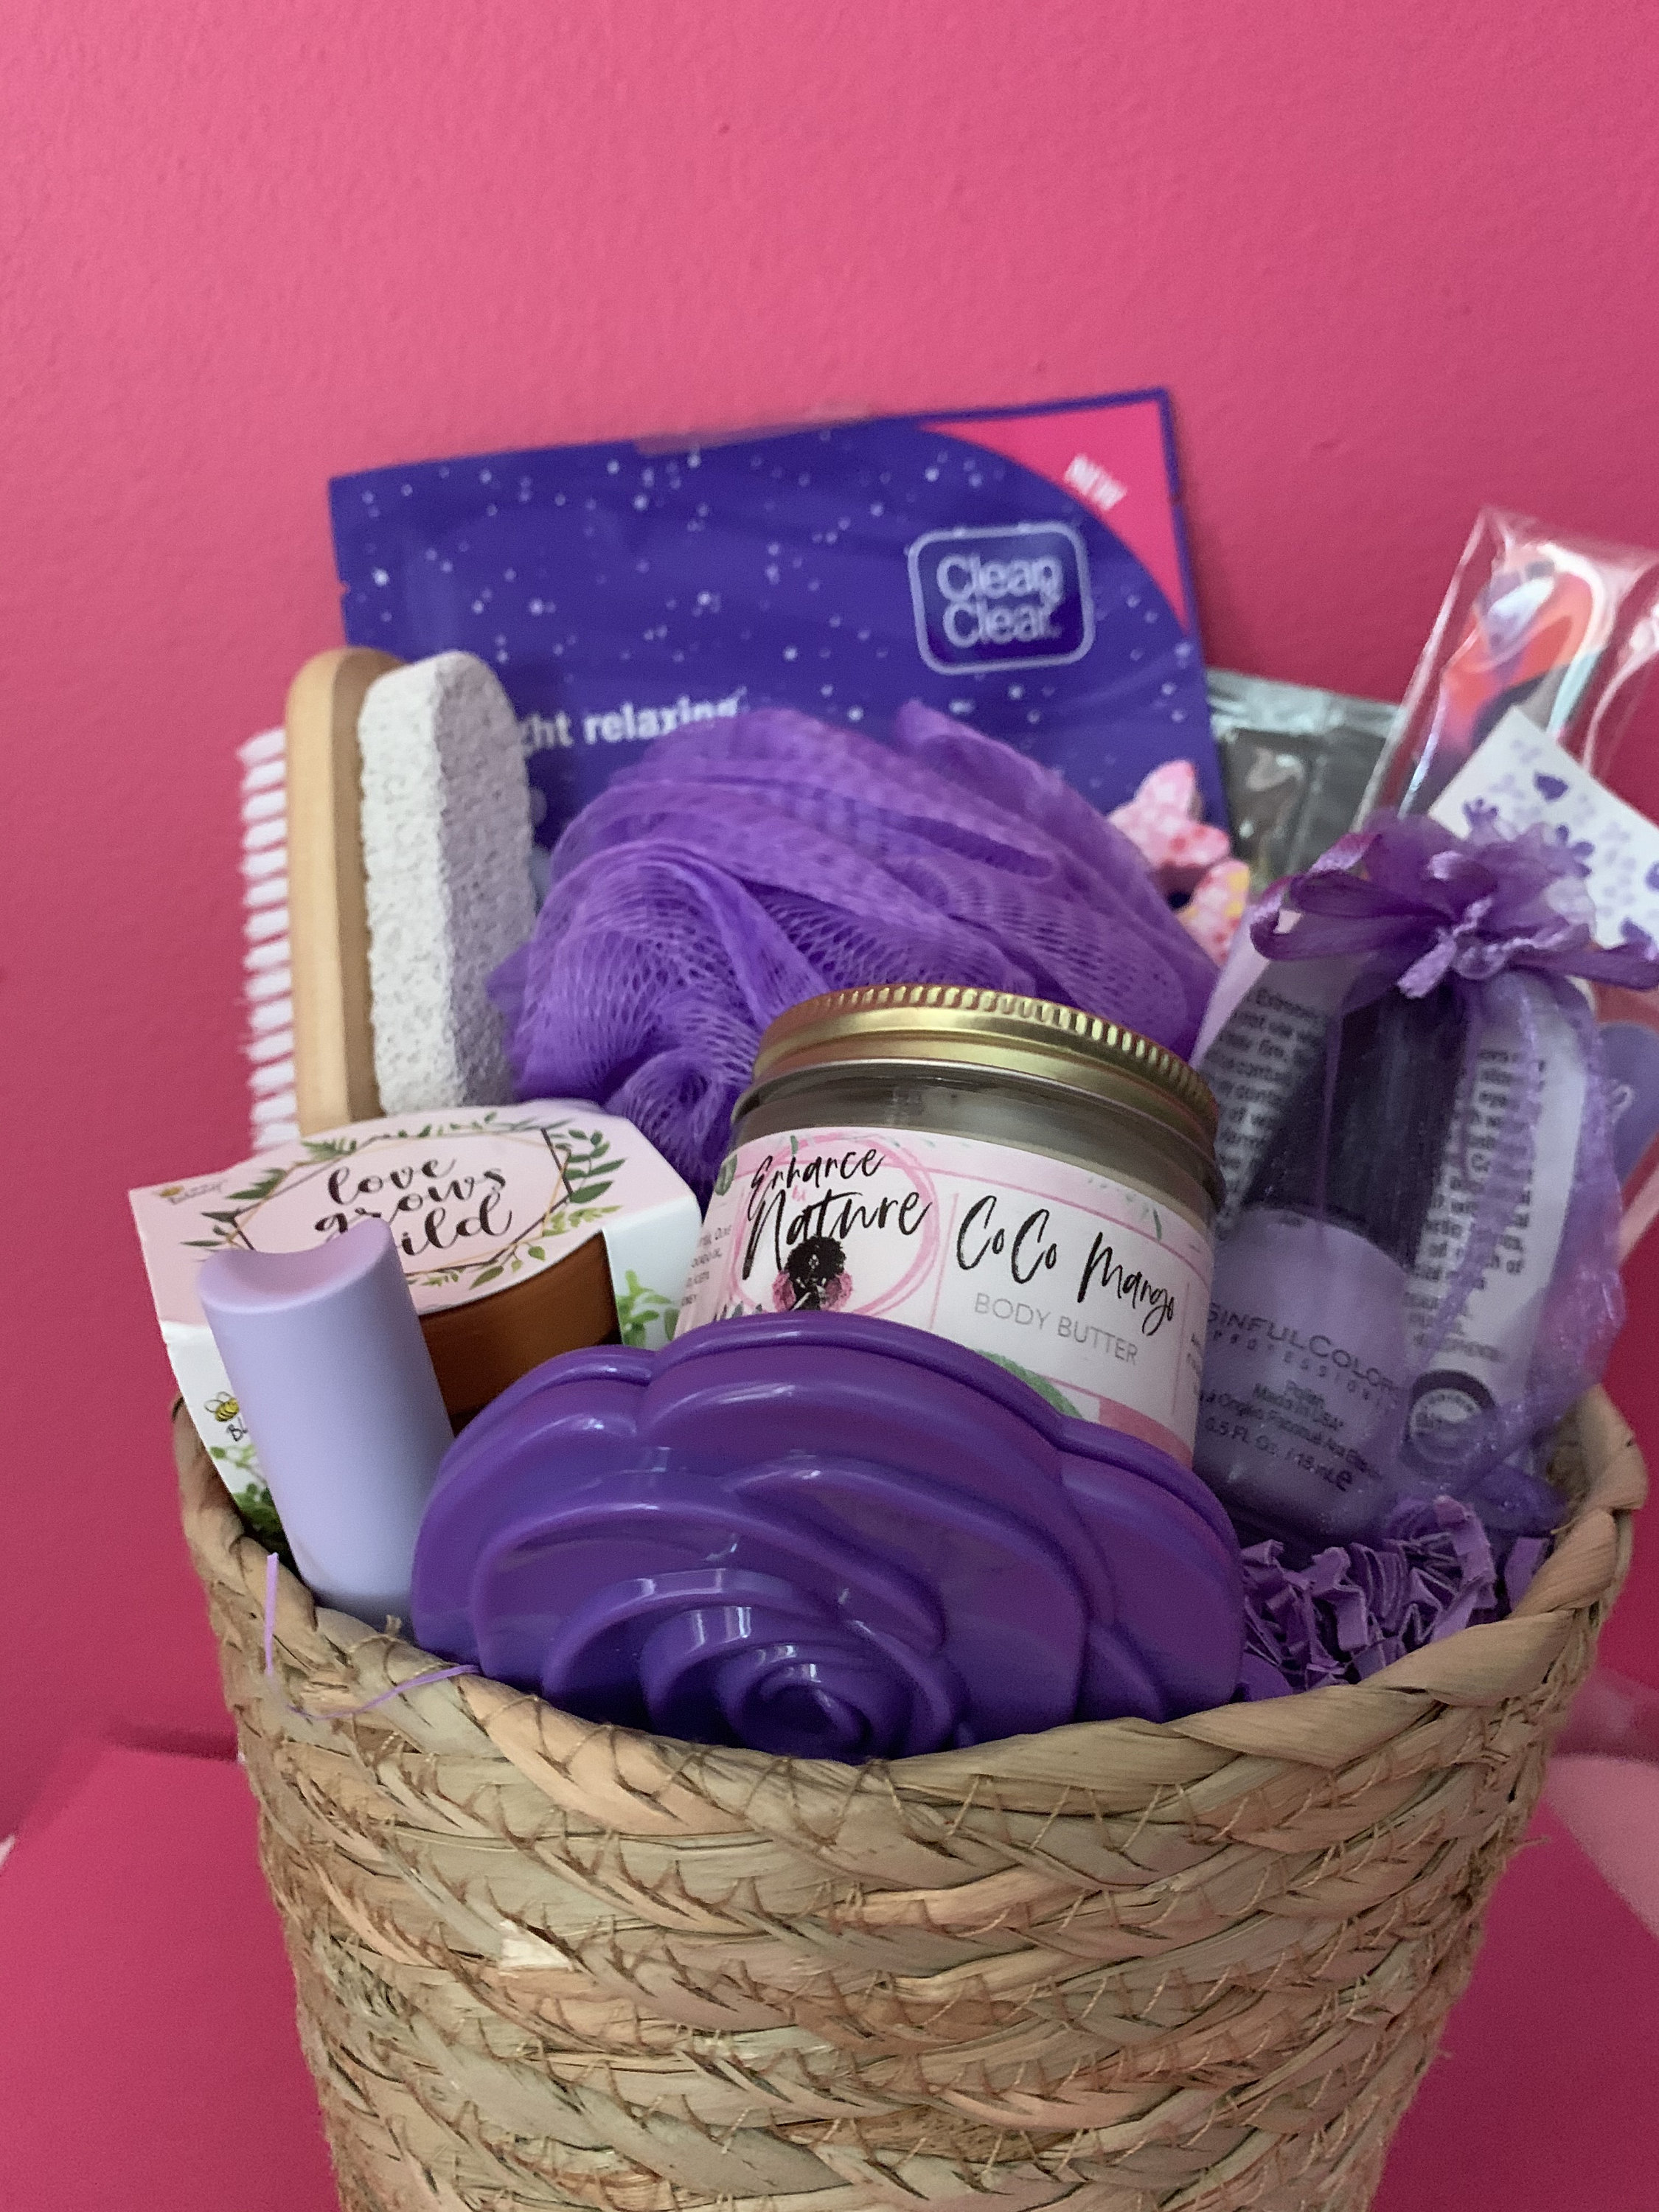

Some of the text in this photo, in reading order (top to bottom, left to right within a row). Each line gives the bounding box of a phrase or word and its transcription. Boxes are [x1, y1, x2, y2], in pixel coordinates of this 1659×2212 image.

[1064, 453, 1128, 511] NEW
[327, 1155, 457, 1205] love
[747, 1148, 886, 1221] Enhance
[400, 1191, 512, 1256] ild
[742, 1188, 933, 1281] Nature
[1077, 1231, 1175, 1336] Mango
[974, 1292, 1051, 1330] BODY
[1057, 1315, 1138, 1366] BUTTER
